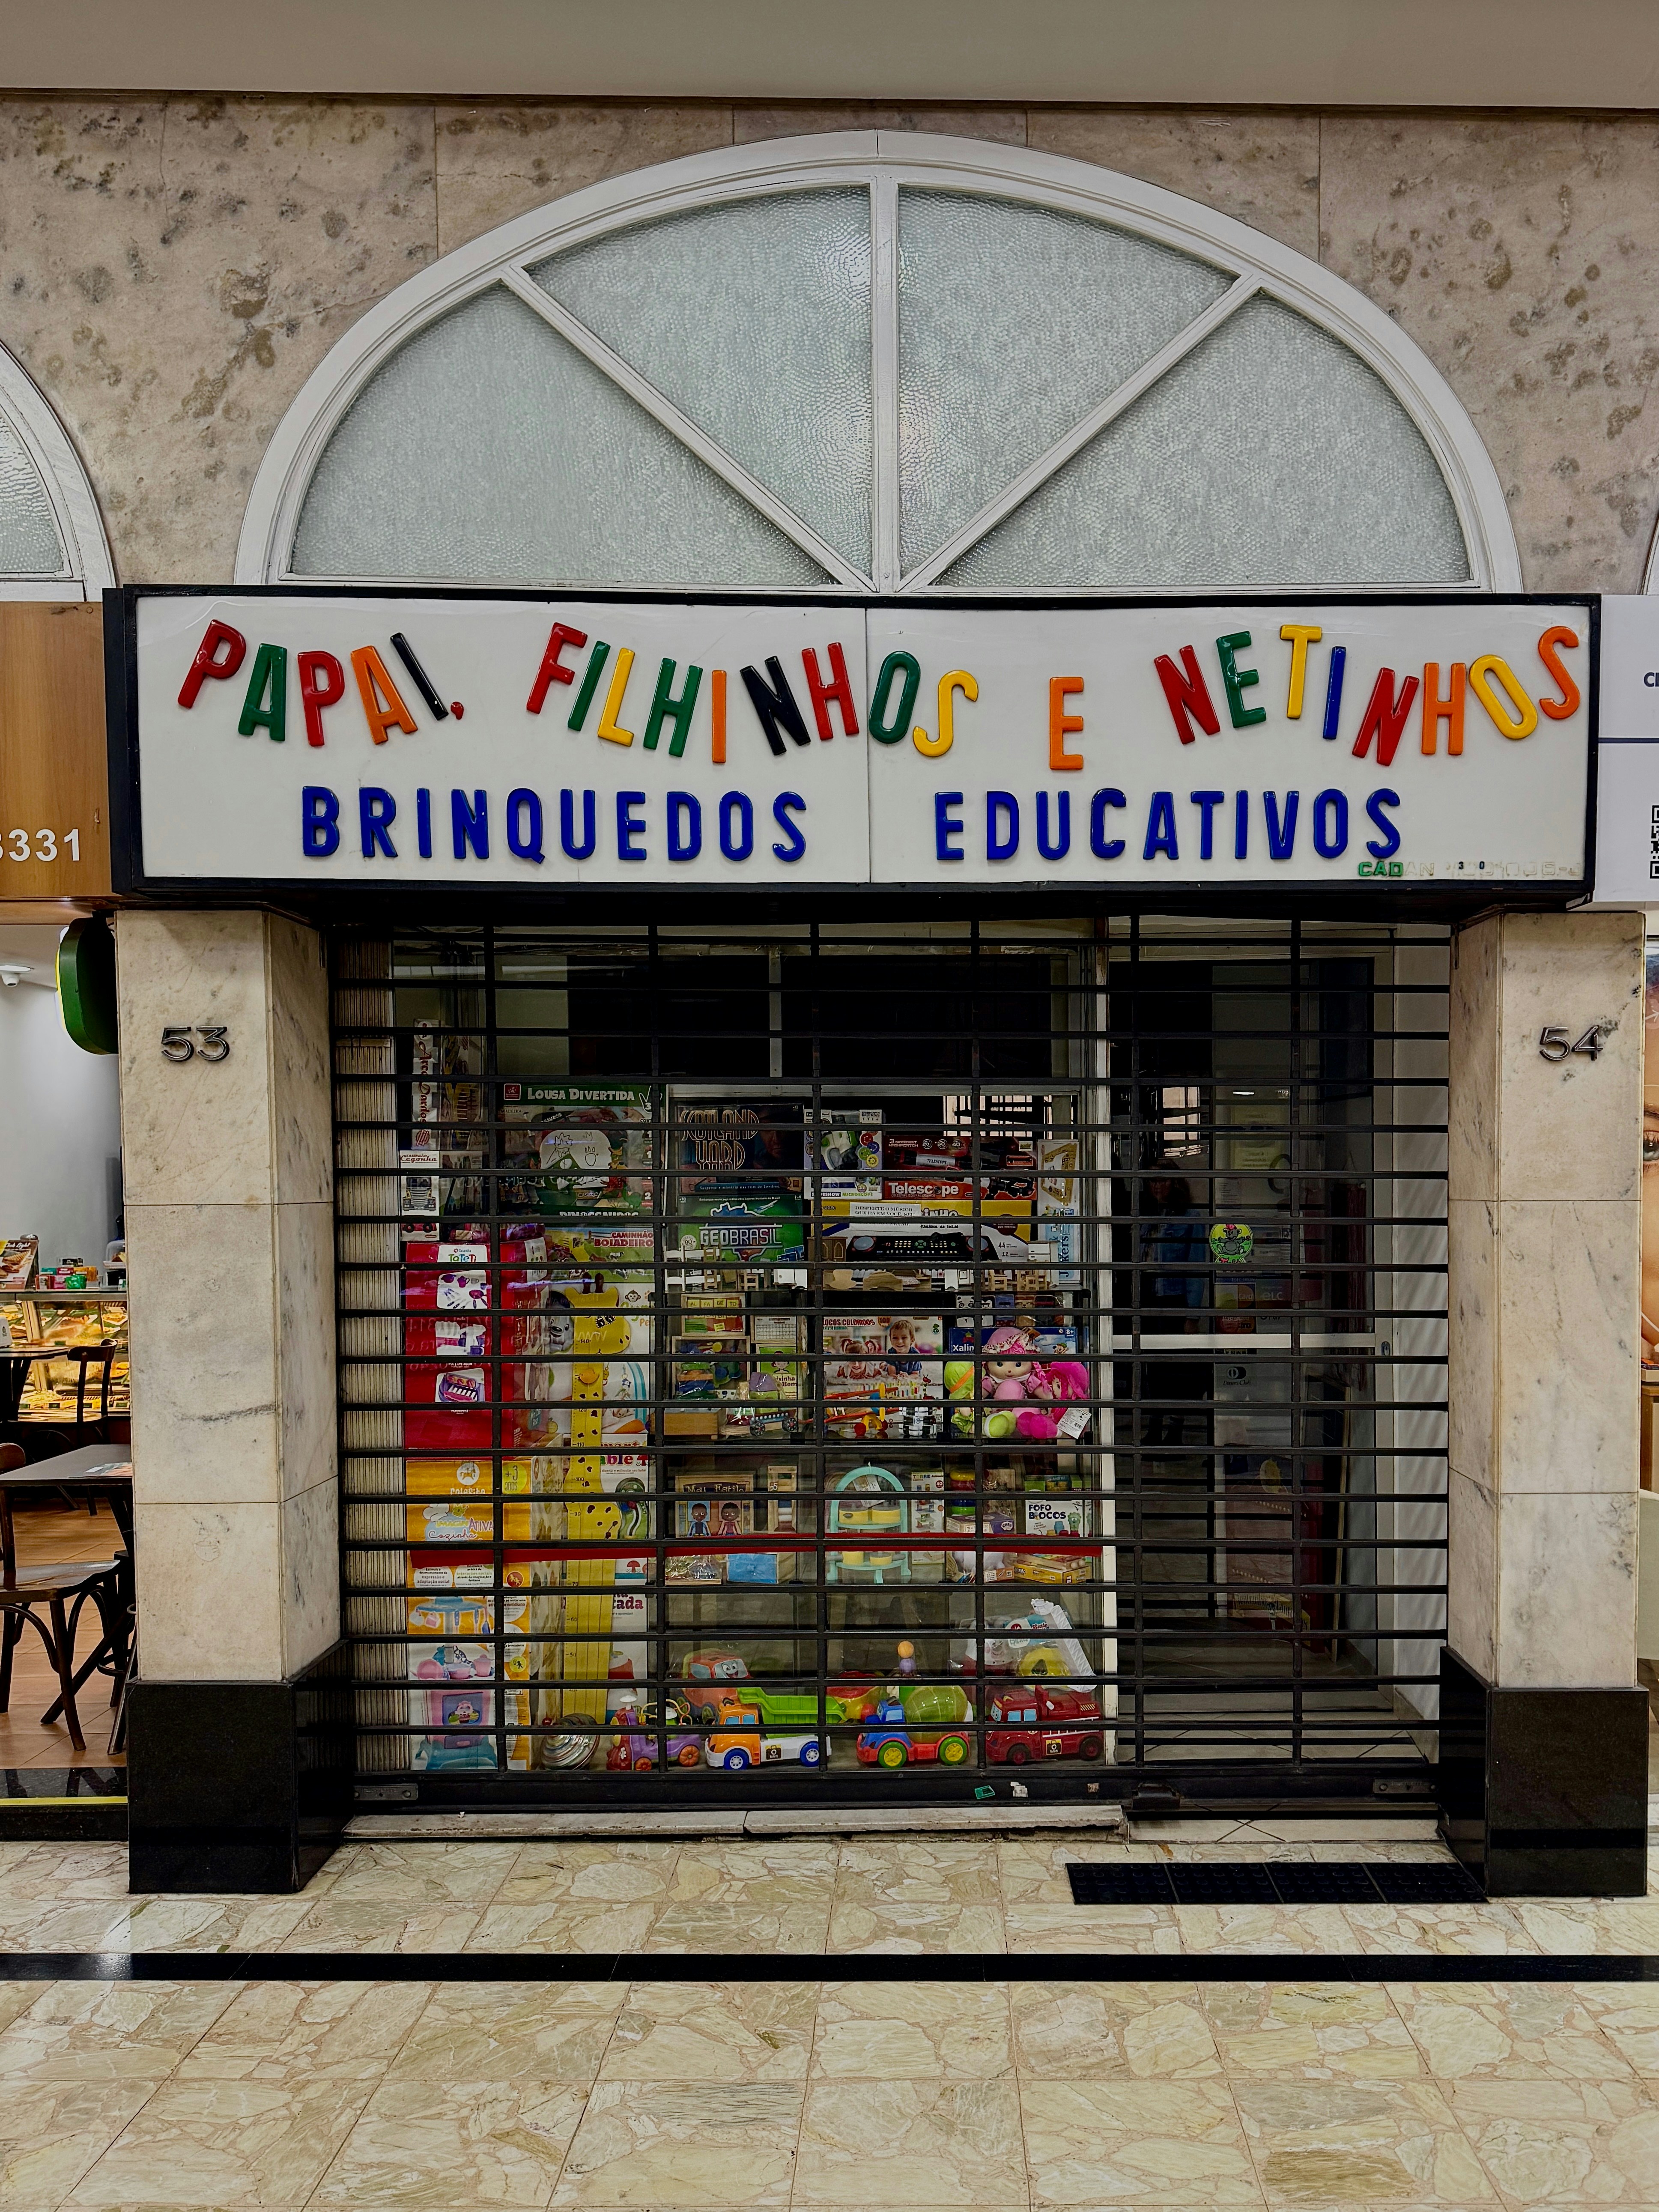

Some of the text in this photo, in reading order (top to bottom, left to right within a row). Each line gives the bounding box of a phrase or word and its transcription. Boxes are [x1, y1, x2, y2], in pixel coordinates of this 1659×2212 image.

[526, 622, 979, 764] FILHINHOS
[1048, 676, 1084, 771] E
[1154, 624, 1581, 767] NETINHOS
[302, 786, 1400, 864] BRINQUEDOS EDUCATIVOS
[0, 828, 81, 862] 331
[161, 1026, 230, 1062] 53
[1539, 1026, 1604, 1061] 54
[594, 1238, 654, 1248] BOIADEIRO
[612, 1230, 653, 1239] CAMINHÃO
[699, 1228, 782, 1246] GEOBRASIL
